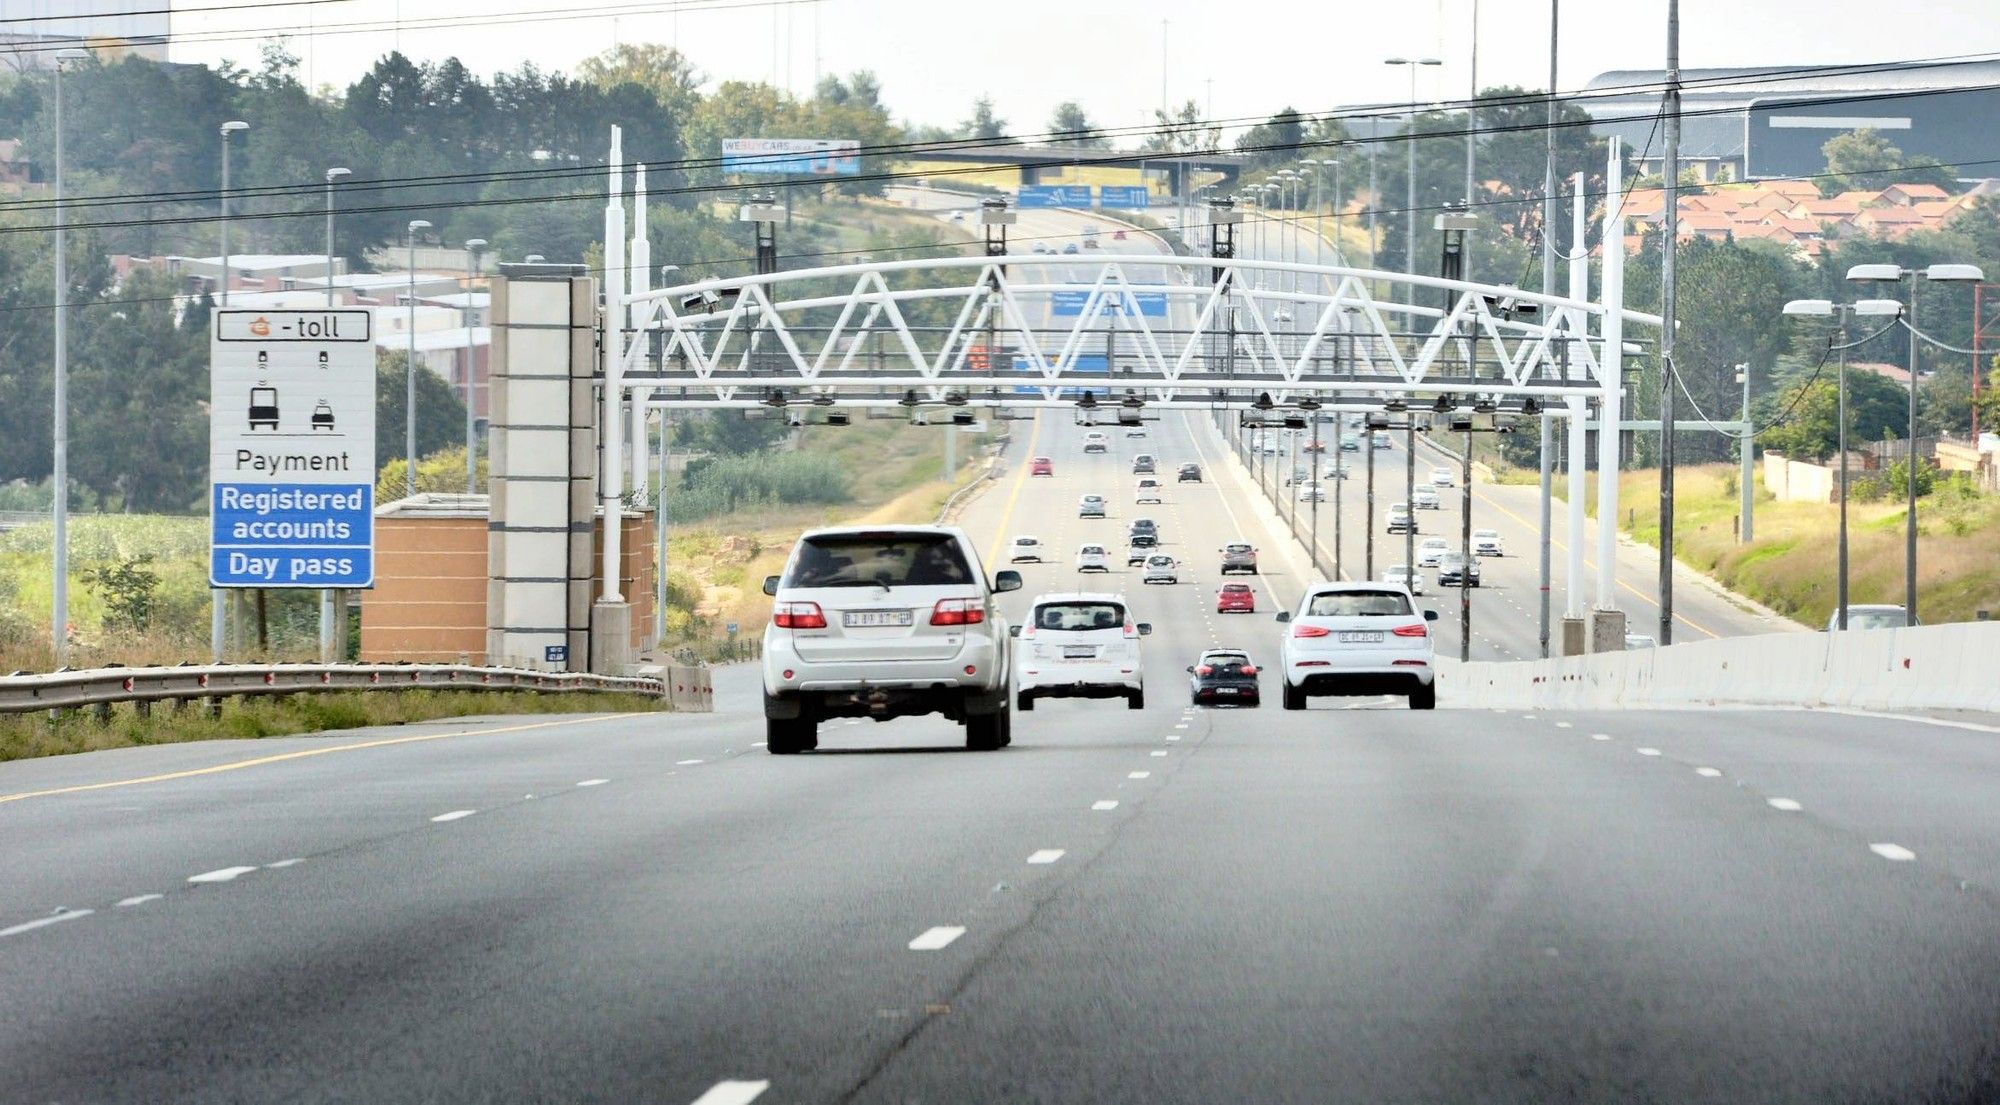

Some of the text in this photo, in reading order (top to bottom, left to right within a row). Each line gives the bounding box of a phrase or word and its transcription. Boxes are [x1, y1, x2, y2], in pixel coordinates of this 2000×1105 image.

[235, 449, 350, 477] Payment
[221, 486, 363, 515] Registered
[232, 517, 351, 540] accounts
[229, 552, 353, 581] Day pass
